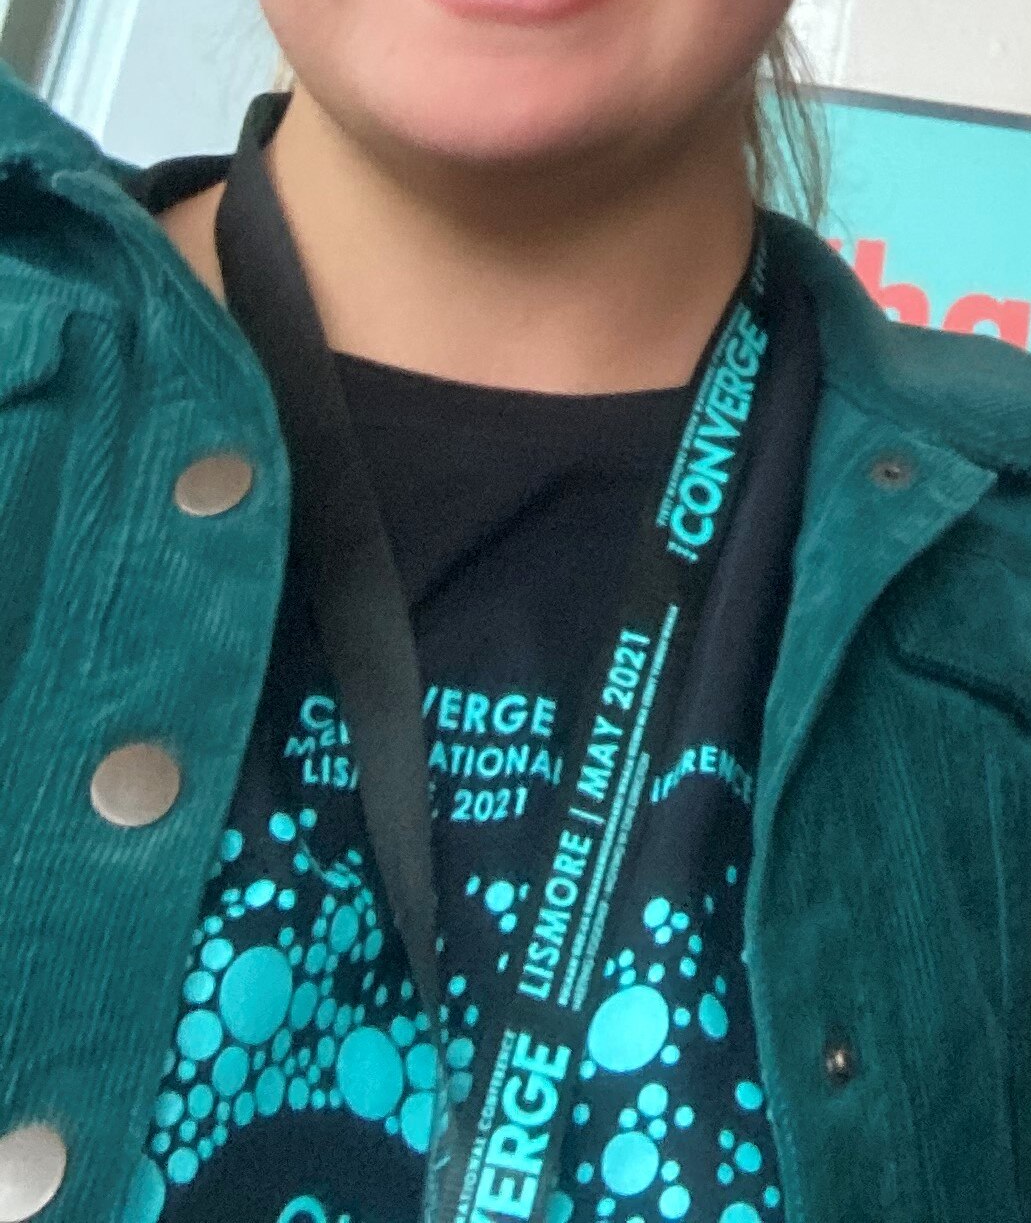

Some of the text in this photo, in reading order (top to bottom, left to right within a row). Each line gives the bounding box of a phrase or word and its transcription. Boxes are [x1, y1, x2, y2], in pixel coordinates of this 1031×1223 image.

[670, 307, 768, 545] CONVERGE
[428, 740, 563, 785] ATIONA
[451, 786, 528, 822] 2021
[518, 830, 592, 1000] LISMORE
[577, 714, 623, 800] MAY
[603, 628, 651, 711] 2021
[468, 1031, 571, 1223] ERGE
